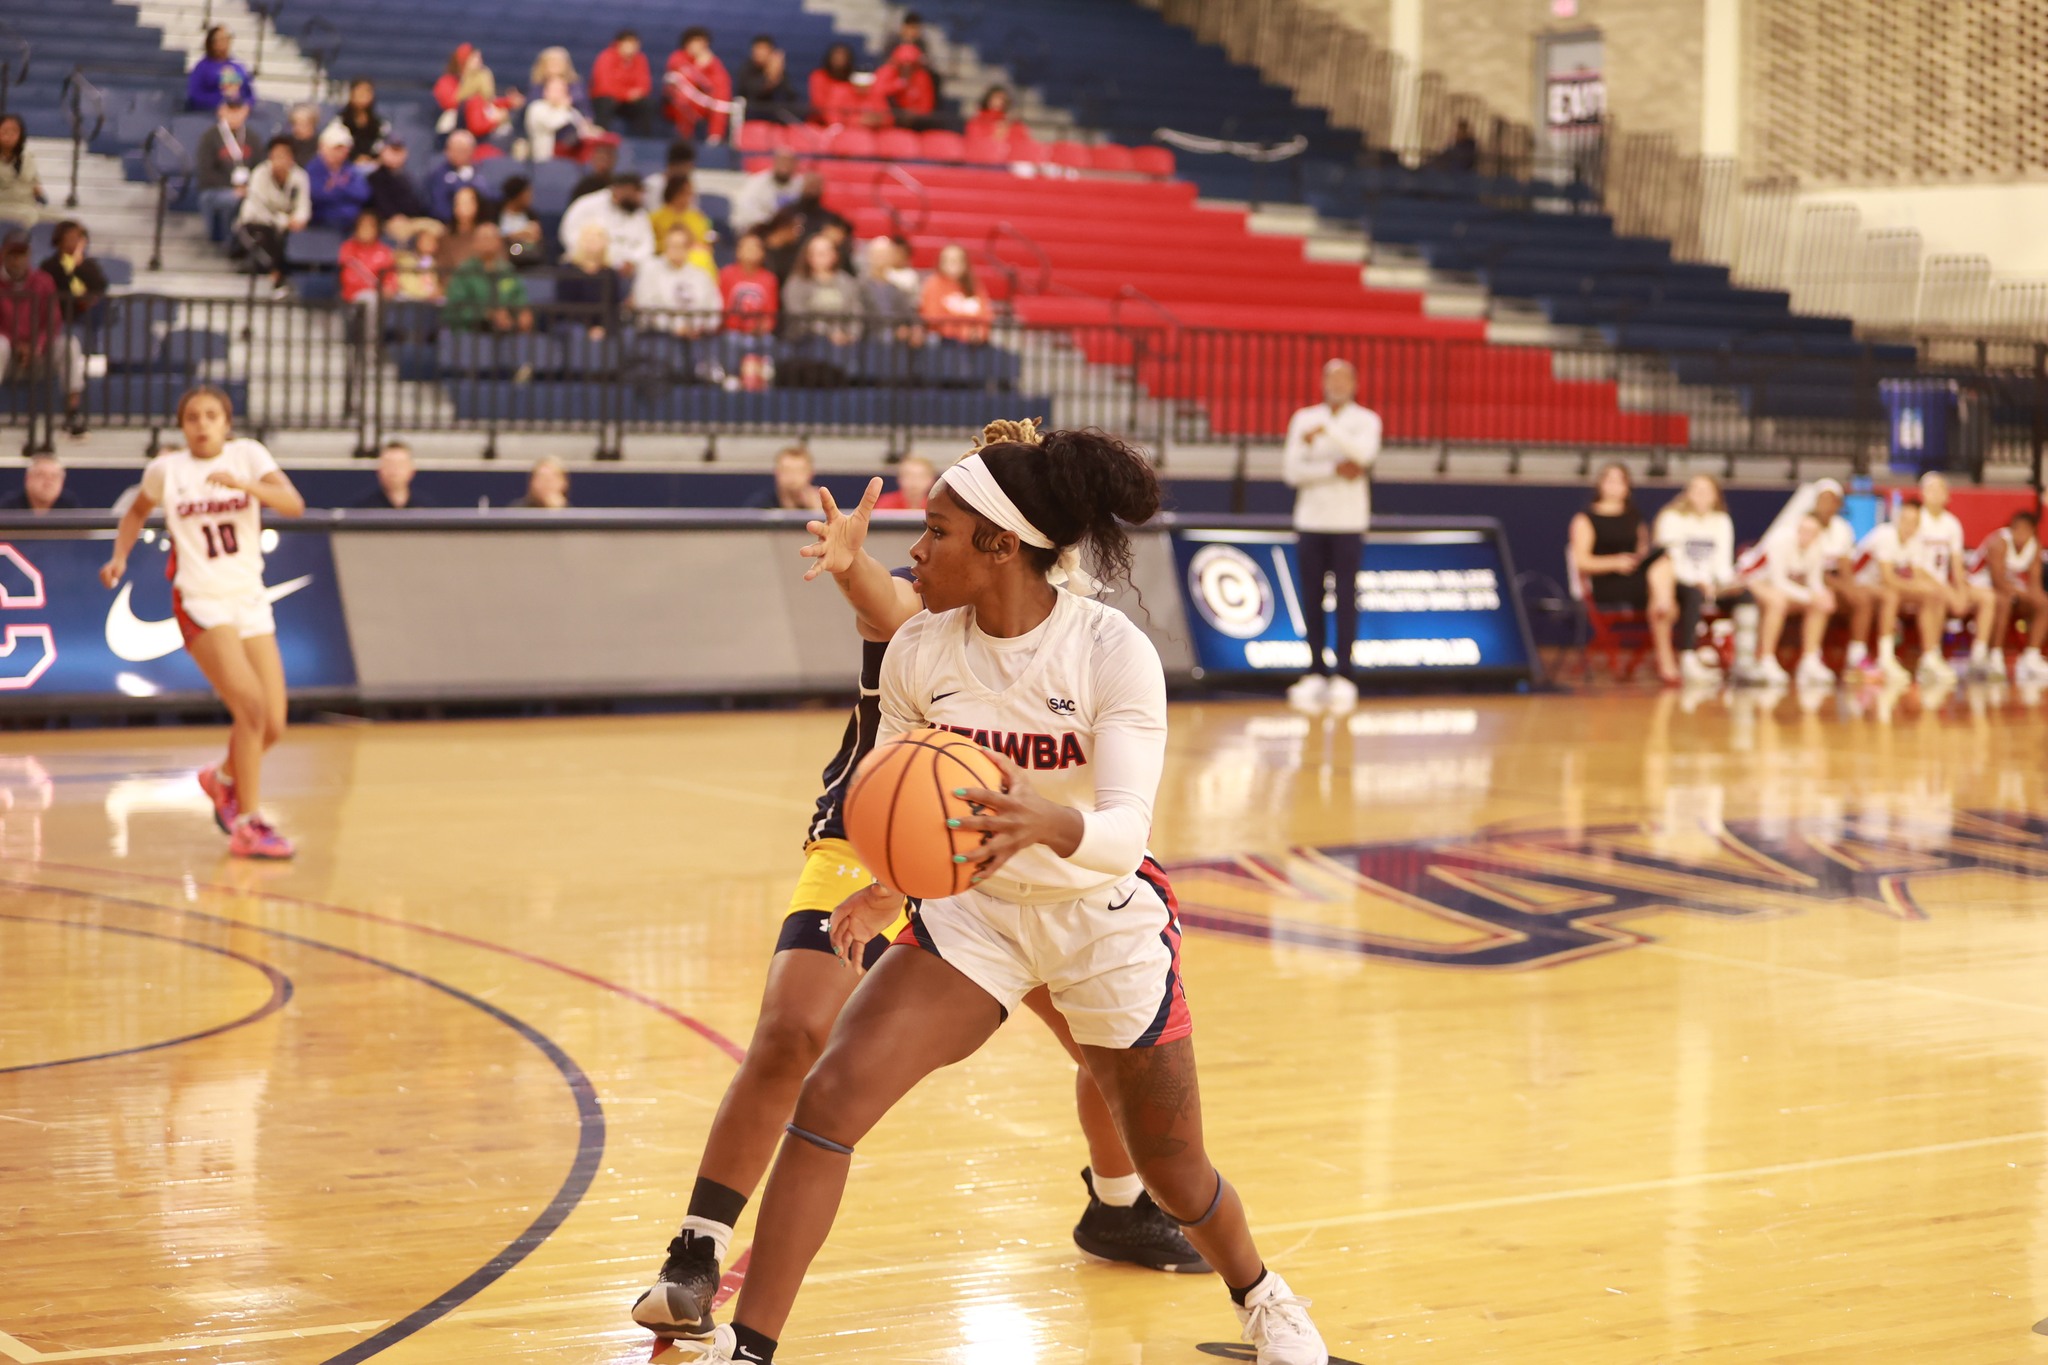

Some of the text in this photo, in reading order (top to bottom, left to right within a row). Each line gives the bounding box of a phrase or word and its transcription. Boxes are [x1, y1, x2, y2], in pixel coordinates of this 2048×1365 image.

[202, 523, 239, 558] 10
[1217, 572, 1246, 609] C
[1049, 698, 1076, 711] SAC
[927, 722, 1087, 770] AWBA
